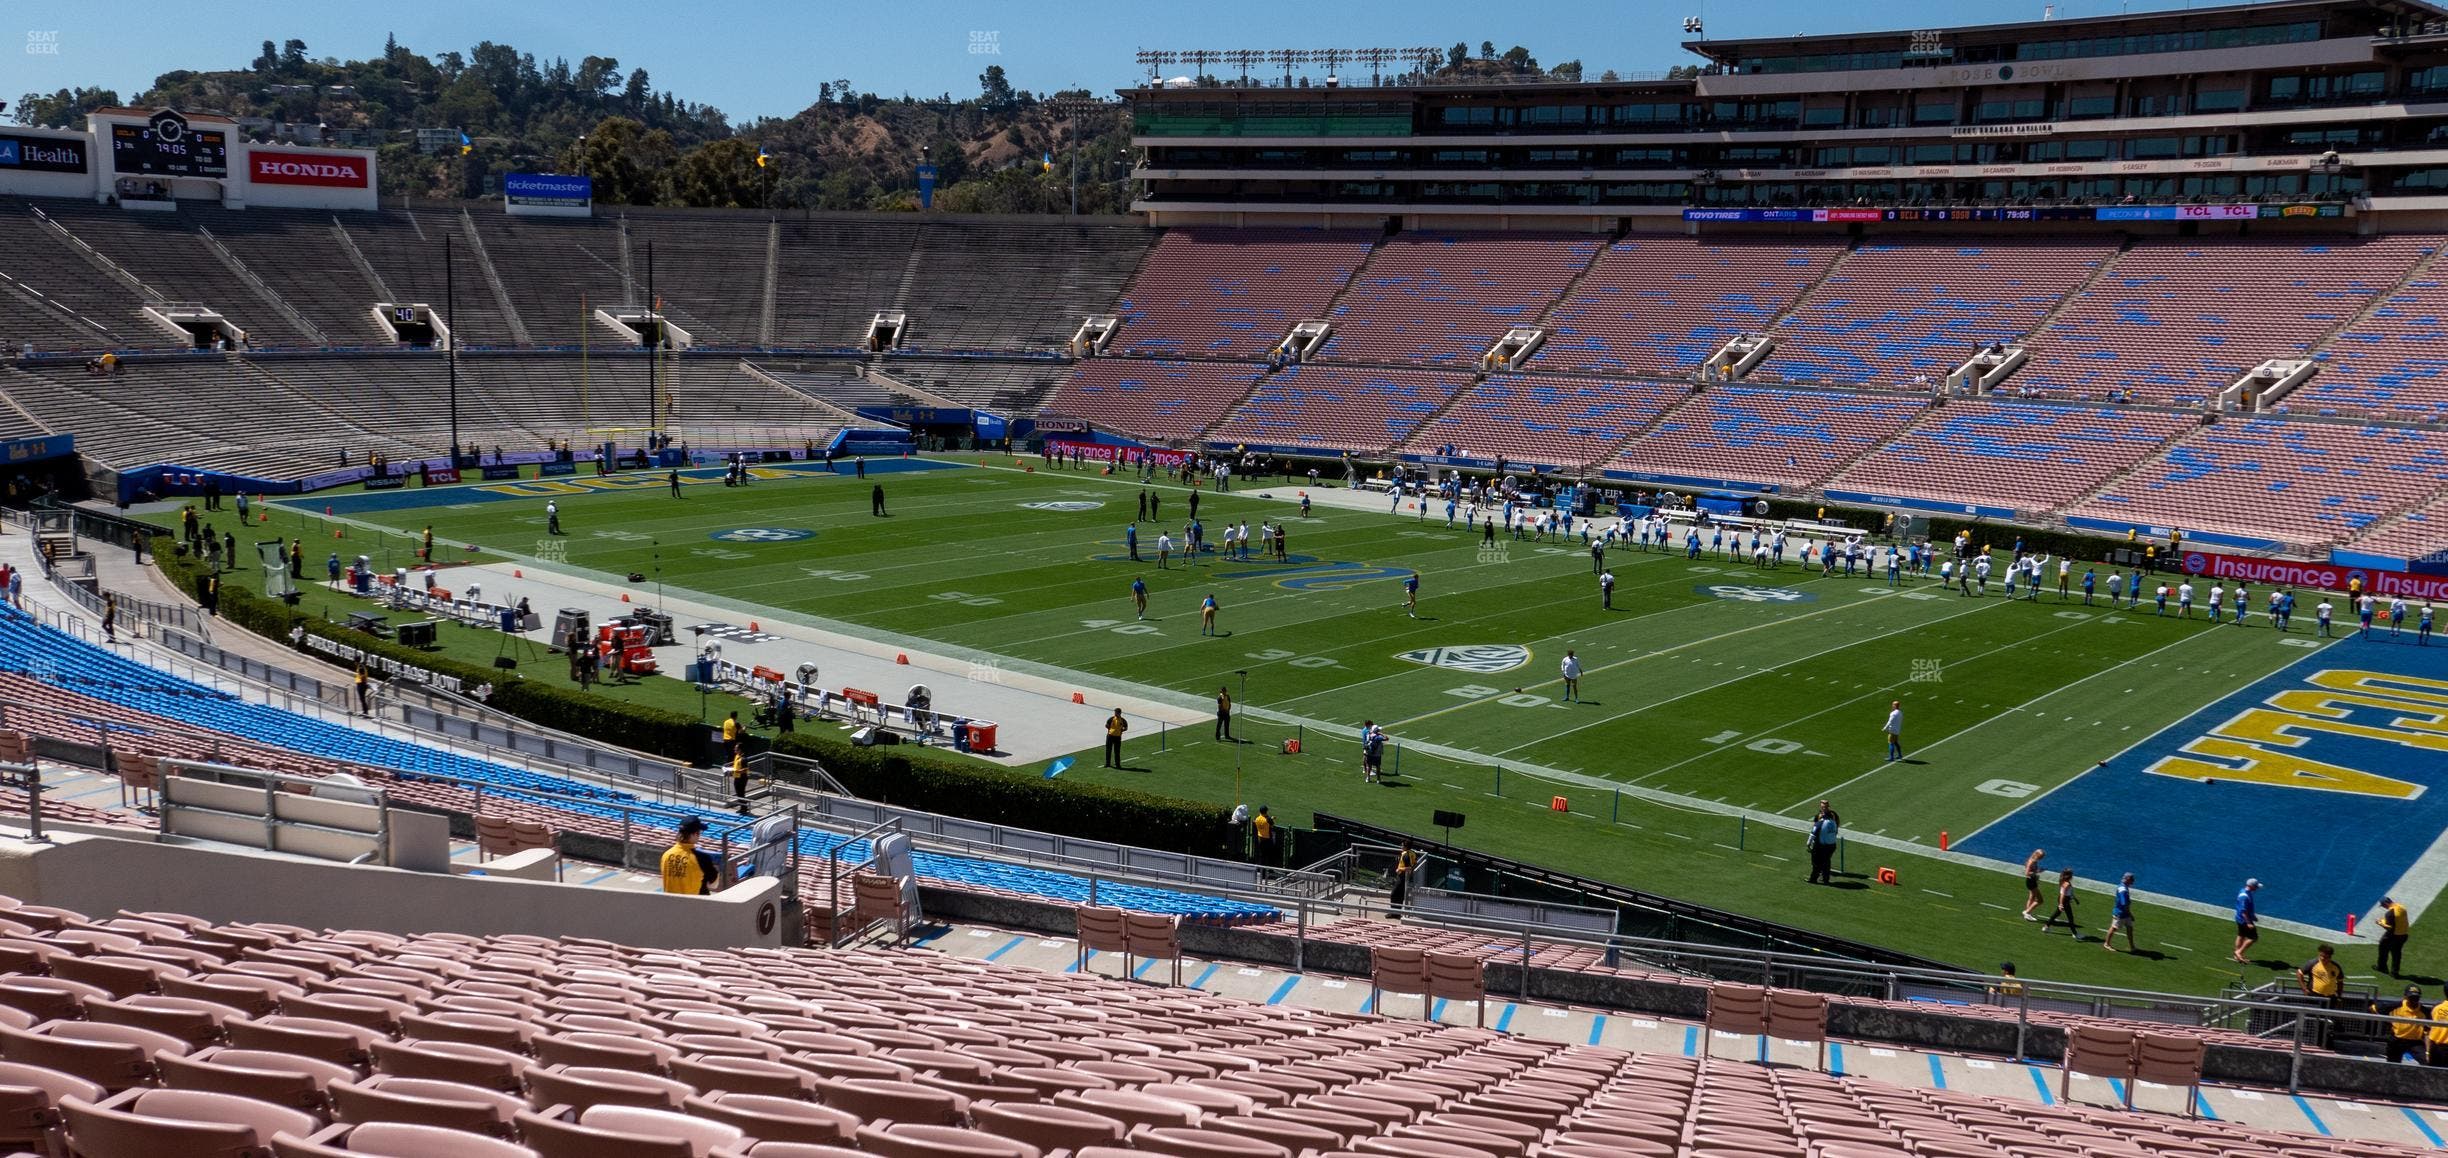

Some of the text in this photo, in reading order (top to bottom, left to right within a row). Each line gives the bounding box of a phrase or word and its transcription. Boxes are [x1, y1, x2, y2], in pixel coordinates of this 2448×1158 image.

[23, 145, 80, 164] Health
[259, 161, 360, 179] HONDA
[507, 181, 584, 192] ticketmaster
[1763, 210, 1798, 218] ONTARIO
[2006, 211, 2029, 219] 79:05
[2184, 207, 2212, 216] TCL
[2223, 206, 2251, 215] TCL
[396, 308, 413, 321] 40
[1036, 420, 1085, 430] HONDA
[367, 478, 403, 487] NISSAN
[431, 471, 457, 483] TCL
[2213, 554, 2337, 587] Insurance
[927, 590, 1003, 607] 50
[1243, 648, 1340, 669] 30
[366, 653, 380, 669] AT
[380, 657, 402, 674] THE
[432, 671, 464, 694] BOWL
[1442, 684, 1553, 709] 20
[1287, 740, 1298, 753] 20
[1701, 729, 1805, 755] 10
[1973, 778, 2042, 798] G
[1555, 798, 1567, 812] 10
[668, 853, 689, 865] CSC
[1880, 870, 1896, 885] G
[763, 909, 772, 928] 7
